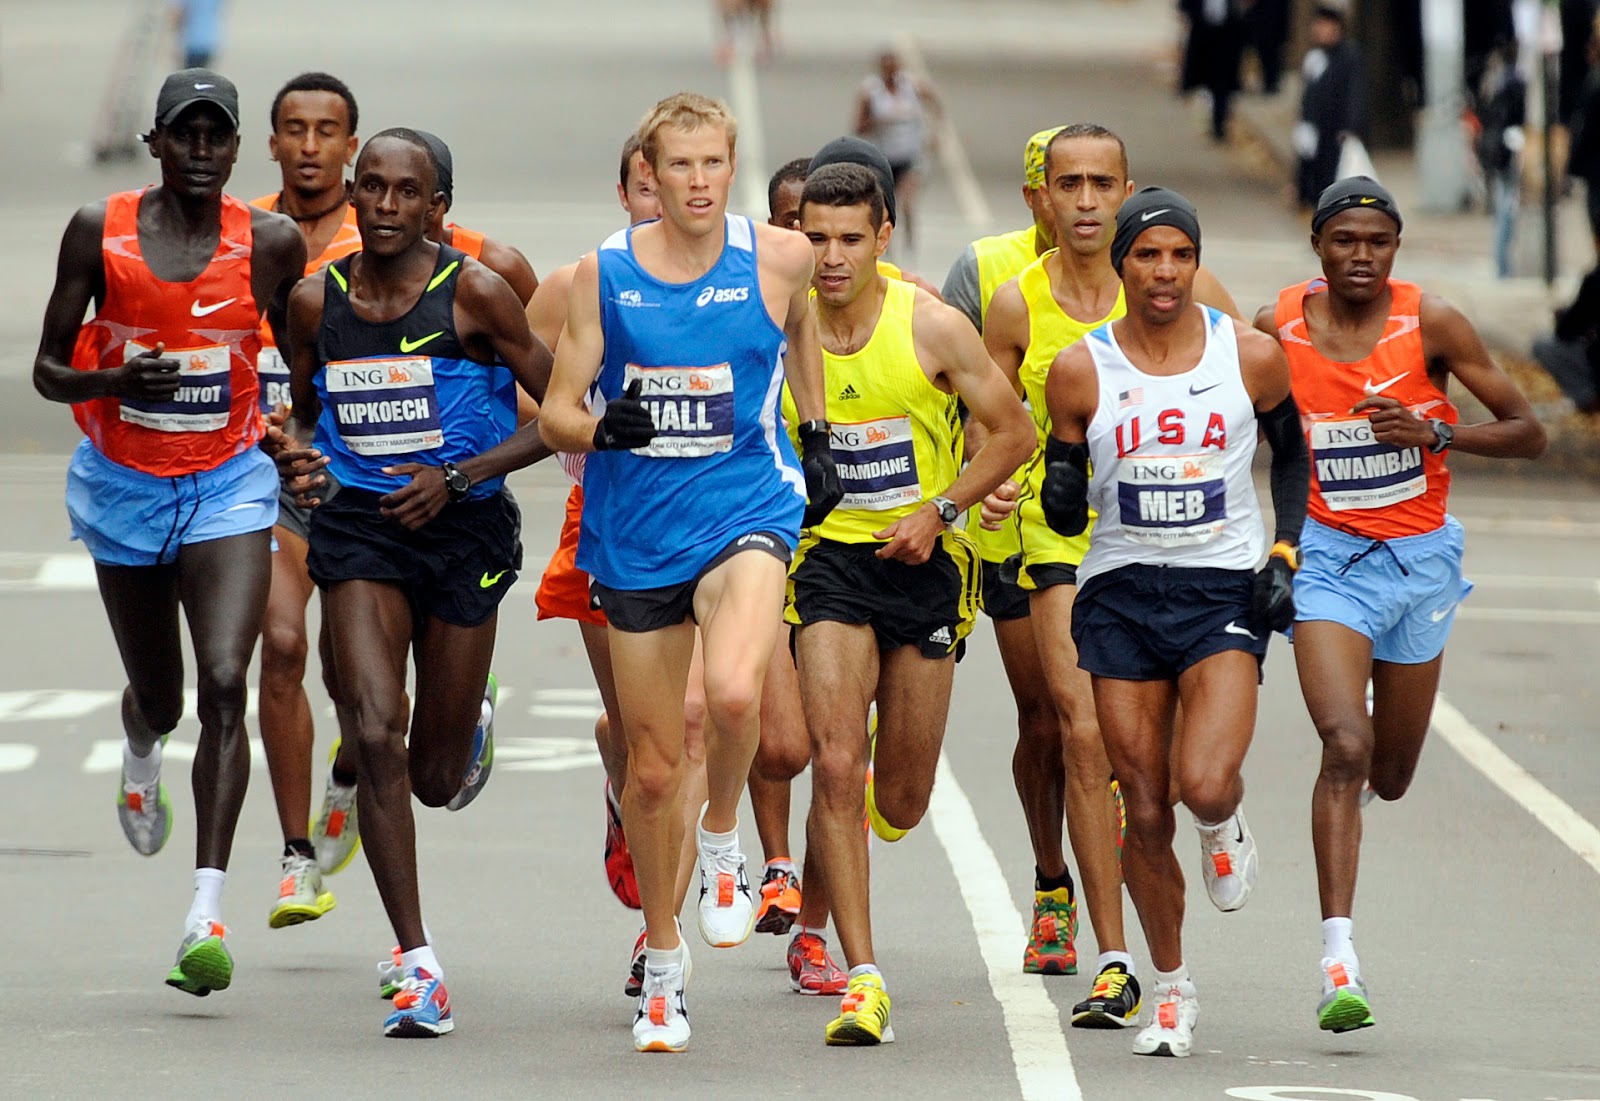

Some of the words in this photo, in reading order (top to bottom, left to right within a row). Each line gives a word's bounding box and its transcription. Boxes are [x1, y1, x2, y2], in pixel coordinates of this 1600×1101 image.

[714, 287, 749, 302] asics
[342, 370, 383, 386] ING
[647, 376, 682, 390] NG
[838, 393, 861, 401] adidas
[337, 397, 430, 424] KIPKOECH
[830, 432, 860, 446] NG
[1116, 408, 1227, 459] USA
[1327, 426, 1370, 443] ING
[390, 438, 423, 446] MARATHON
[1316, 446, 1421, 481] KWAMBAI
[1132, 465, 1177, 480] ING
[855, 497, 867, 505] CITY
[867, 493, 902, 504] MARATHON
[1378, 487, 1410, 499] MARATHON
[1138, 490, 1206, 522] MEB
[1163, 532, 1177, 540] CITY
